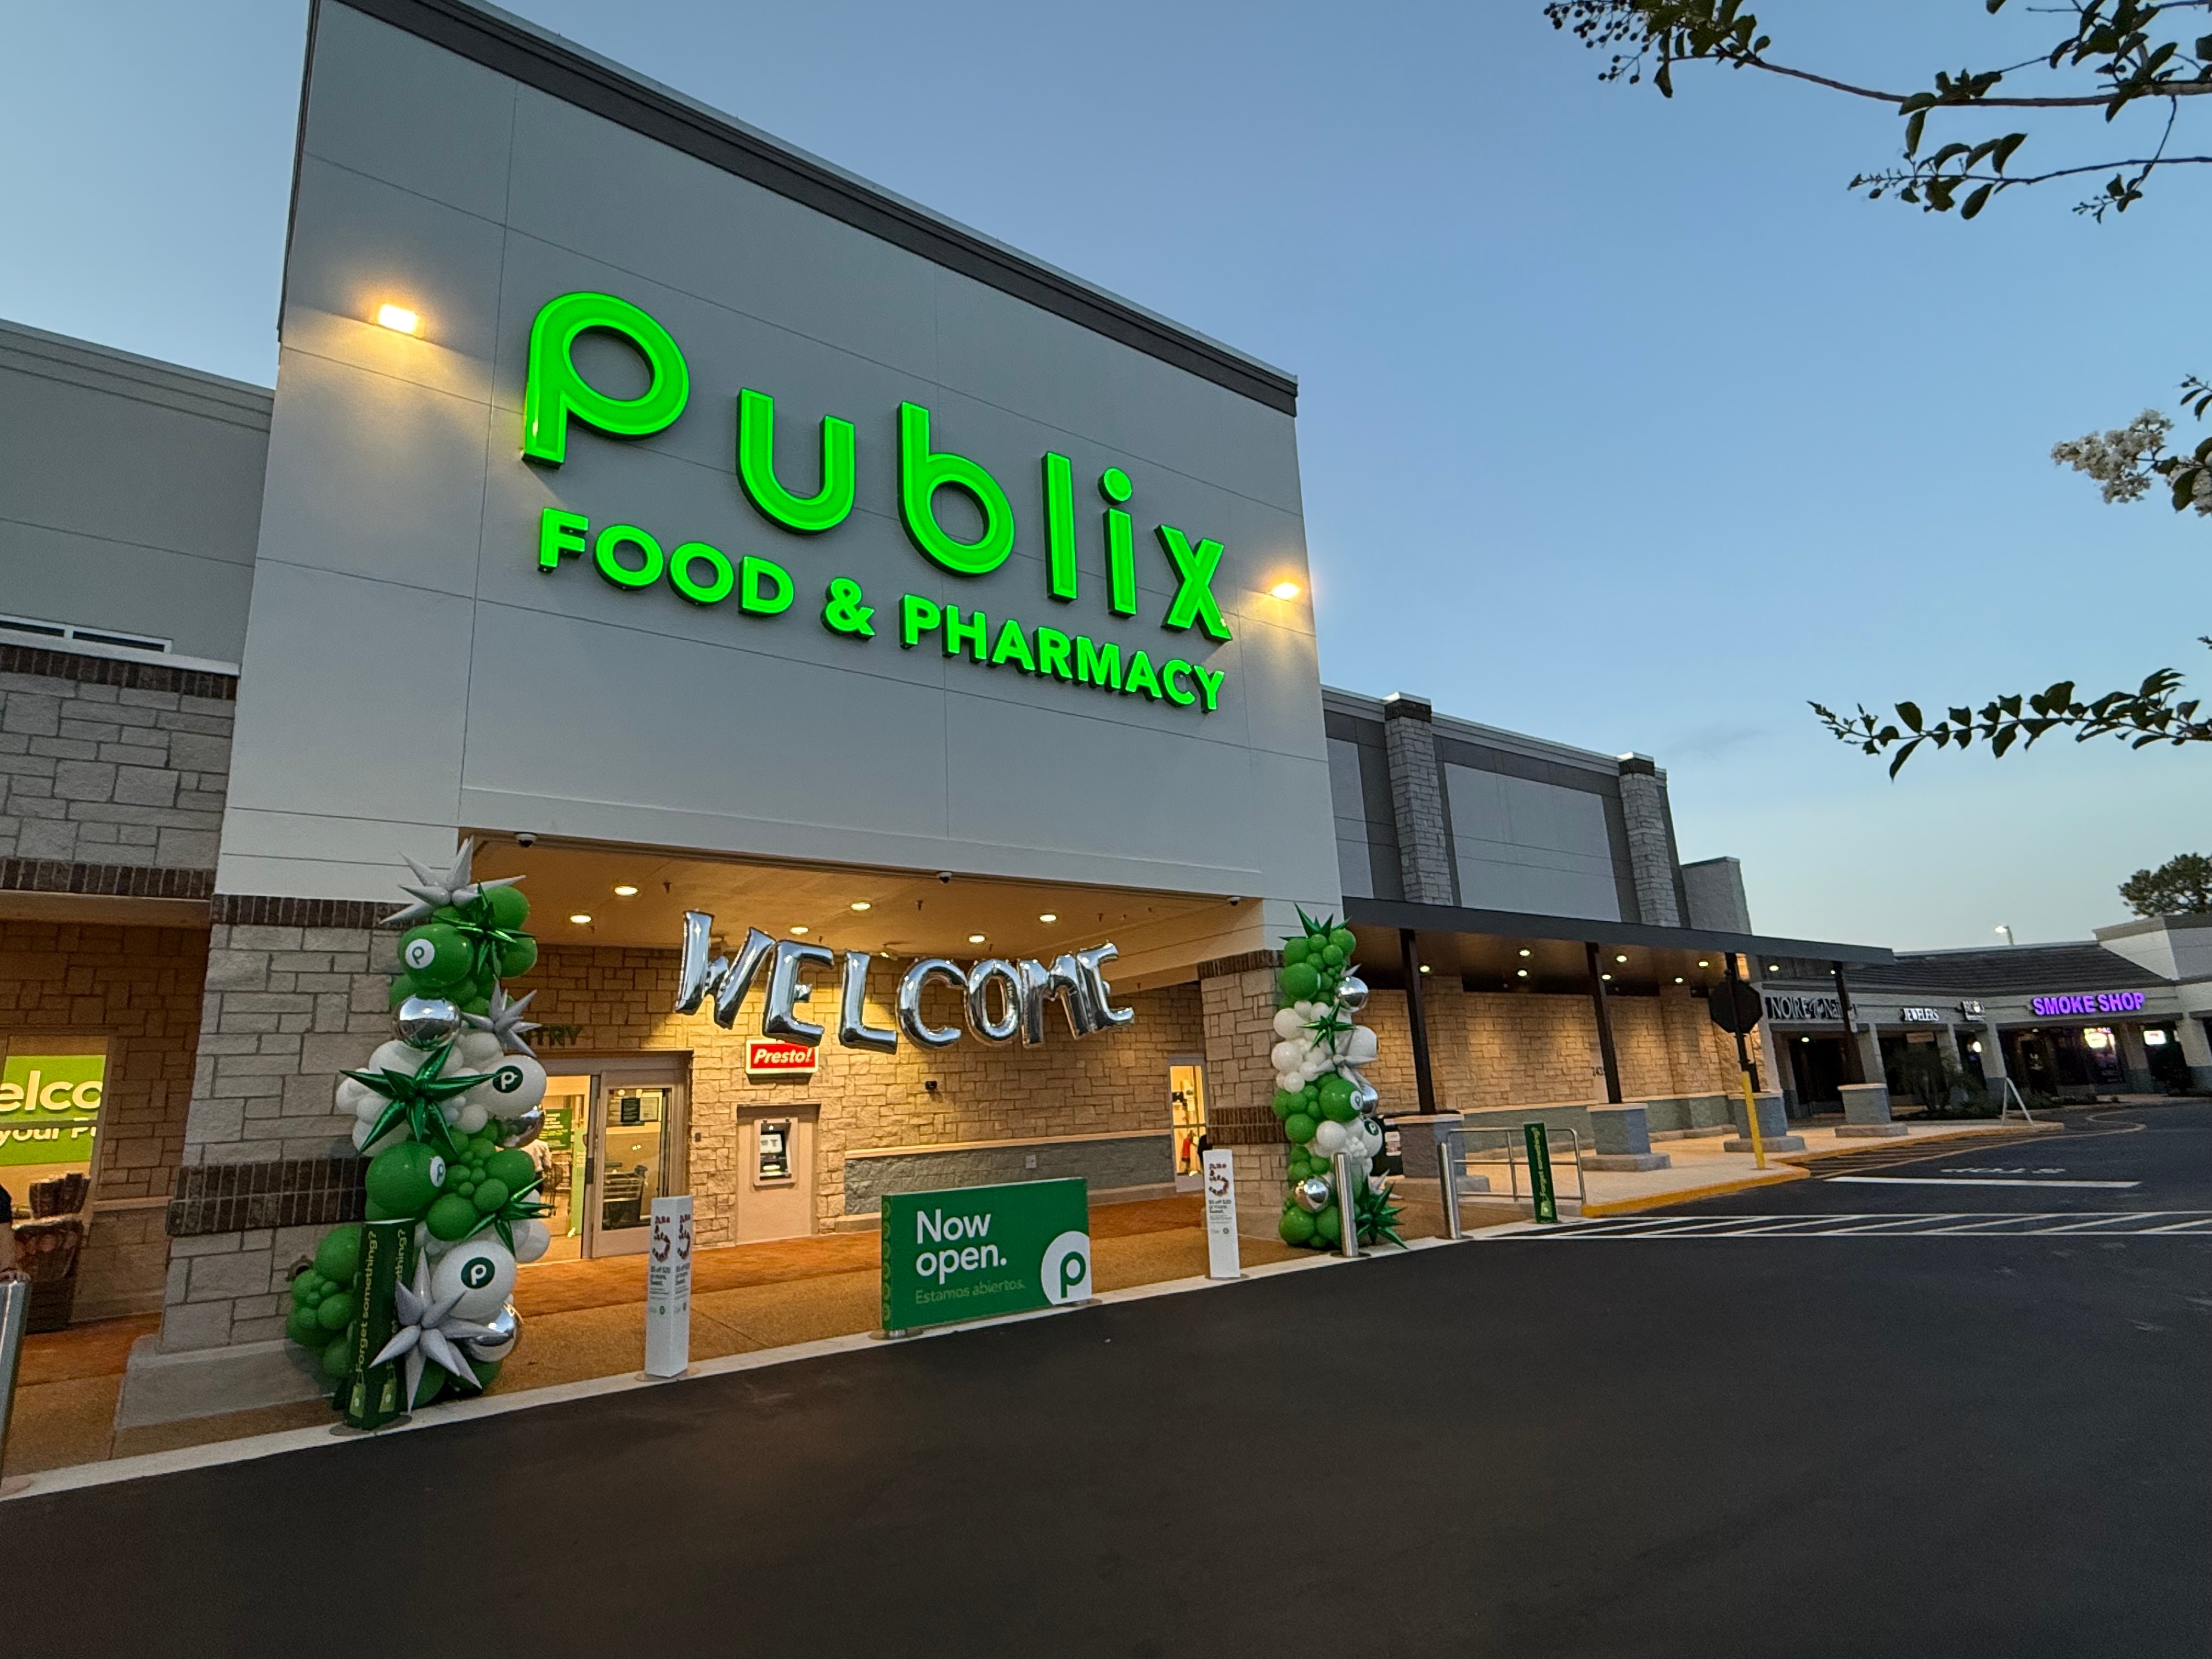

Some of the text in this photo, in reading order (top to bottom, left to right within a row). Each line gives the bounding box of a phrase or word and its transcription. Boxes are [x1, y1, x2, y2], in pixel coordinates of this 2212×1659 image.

[522, 291, 1231, 641] Publix
[539, 507, 1226, 712] FOOD & PHARMACY
[675, 910, 1135, 1055] WELCOME
[1771, 997, 1812, 1019] NOIRE
[2033, 992, 2146, 1015] SMOKE SHOP
[517, 1025, 584, 1046] NTRY
[754, 1047, 812, 1065] Presto!
[0, 1070, 103, 1111] elco
[917, 1209, 991, 1244] Now
[916, 1244, 1007, 1285] open.
[356, 1230, 378, 1372] Forget something?
[915, 1279, 1026, 1305] Estamos abiertos.
